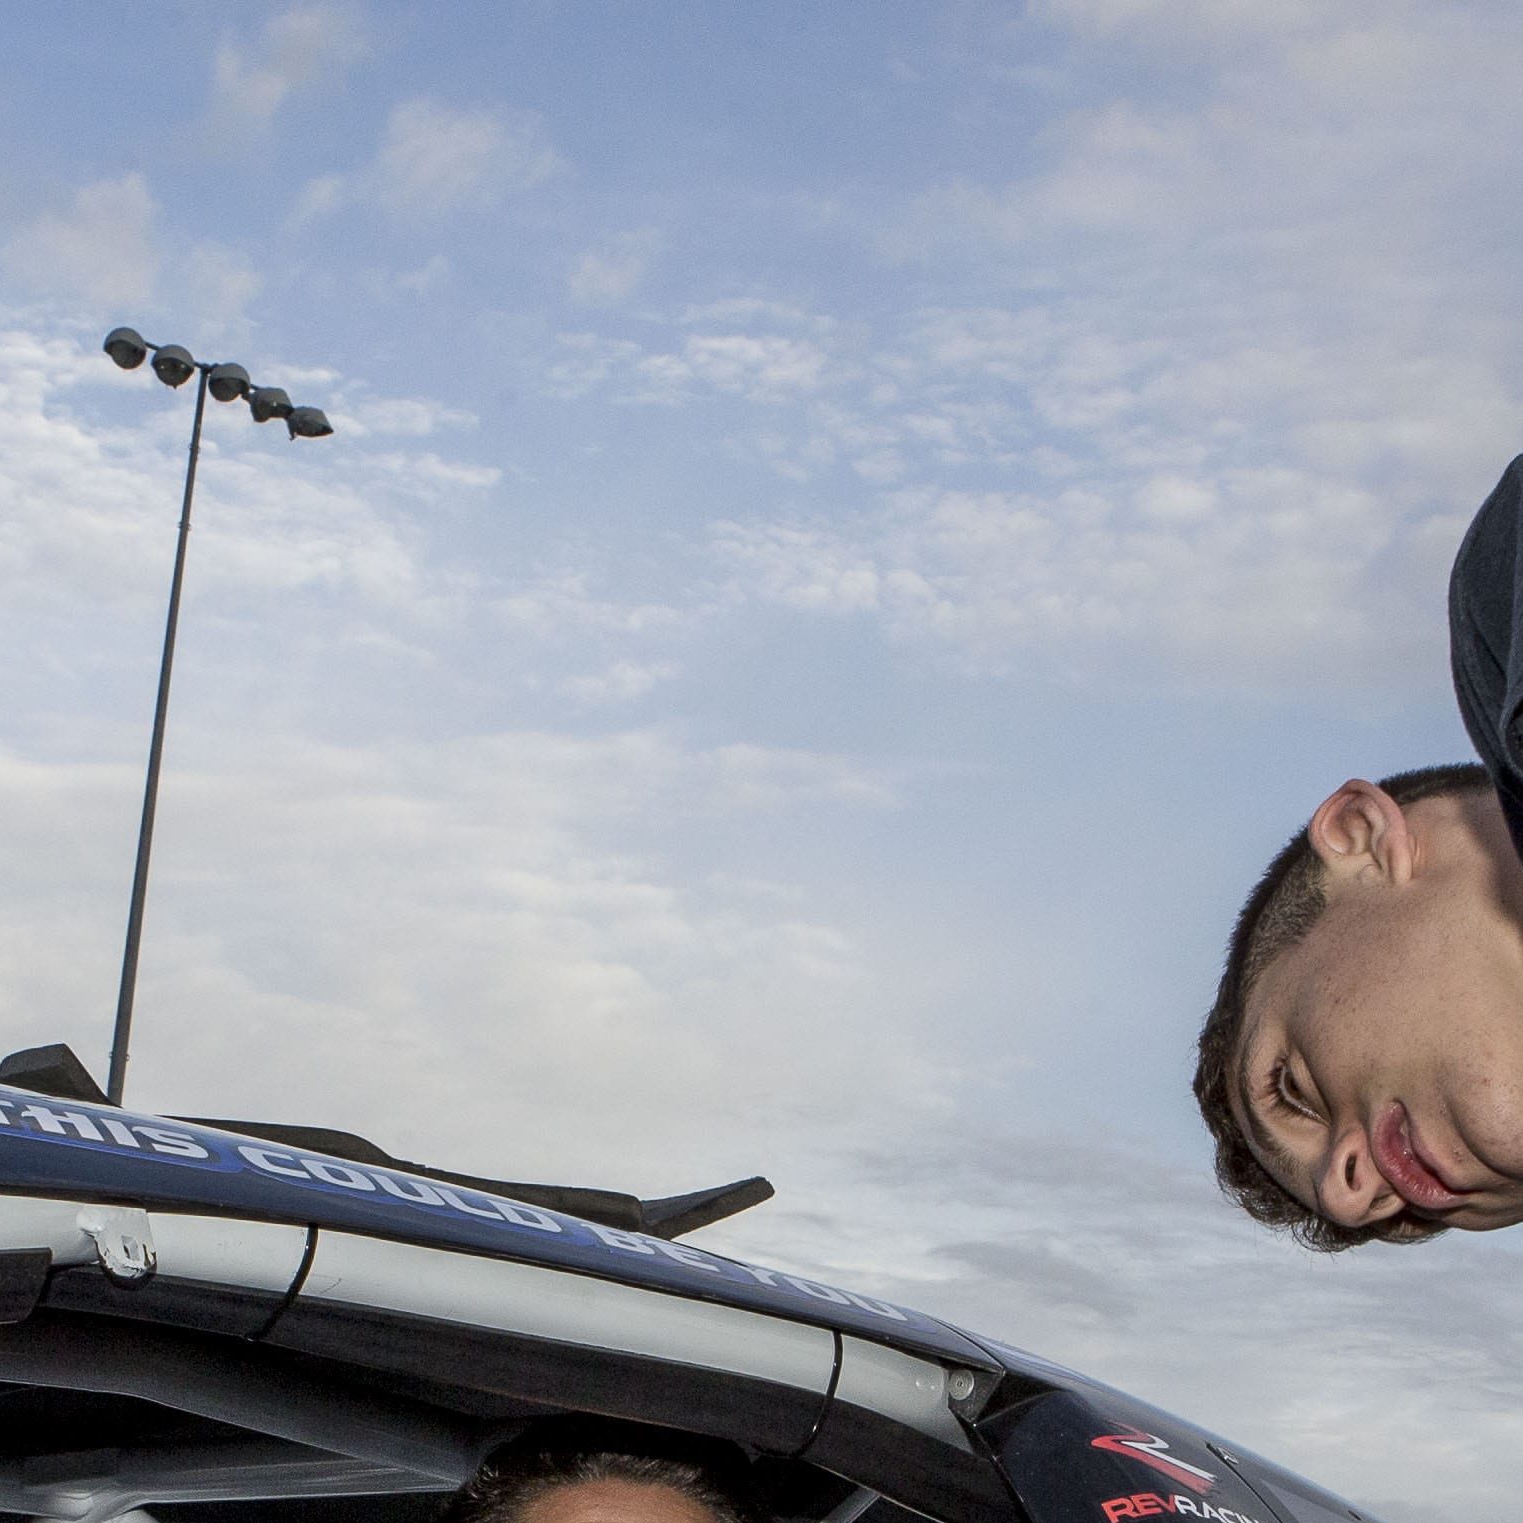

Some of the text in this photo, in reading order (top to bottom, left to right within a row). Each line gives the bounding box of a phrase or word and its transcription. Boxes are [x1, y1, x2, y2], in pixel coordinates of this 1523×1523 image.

[237, 1143, 562, 1234] COULD
[580, 1222, 723, 1273] BE
[747, 1265, 910, 1322] YOU
